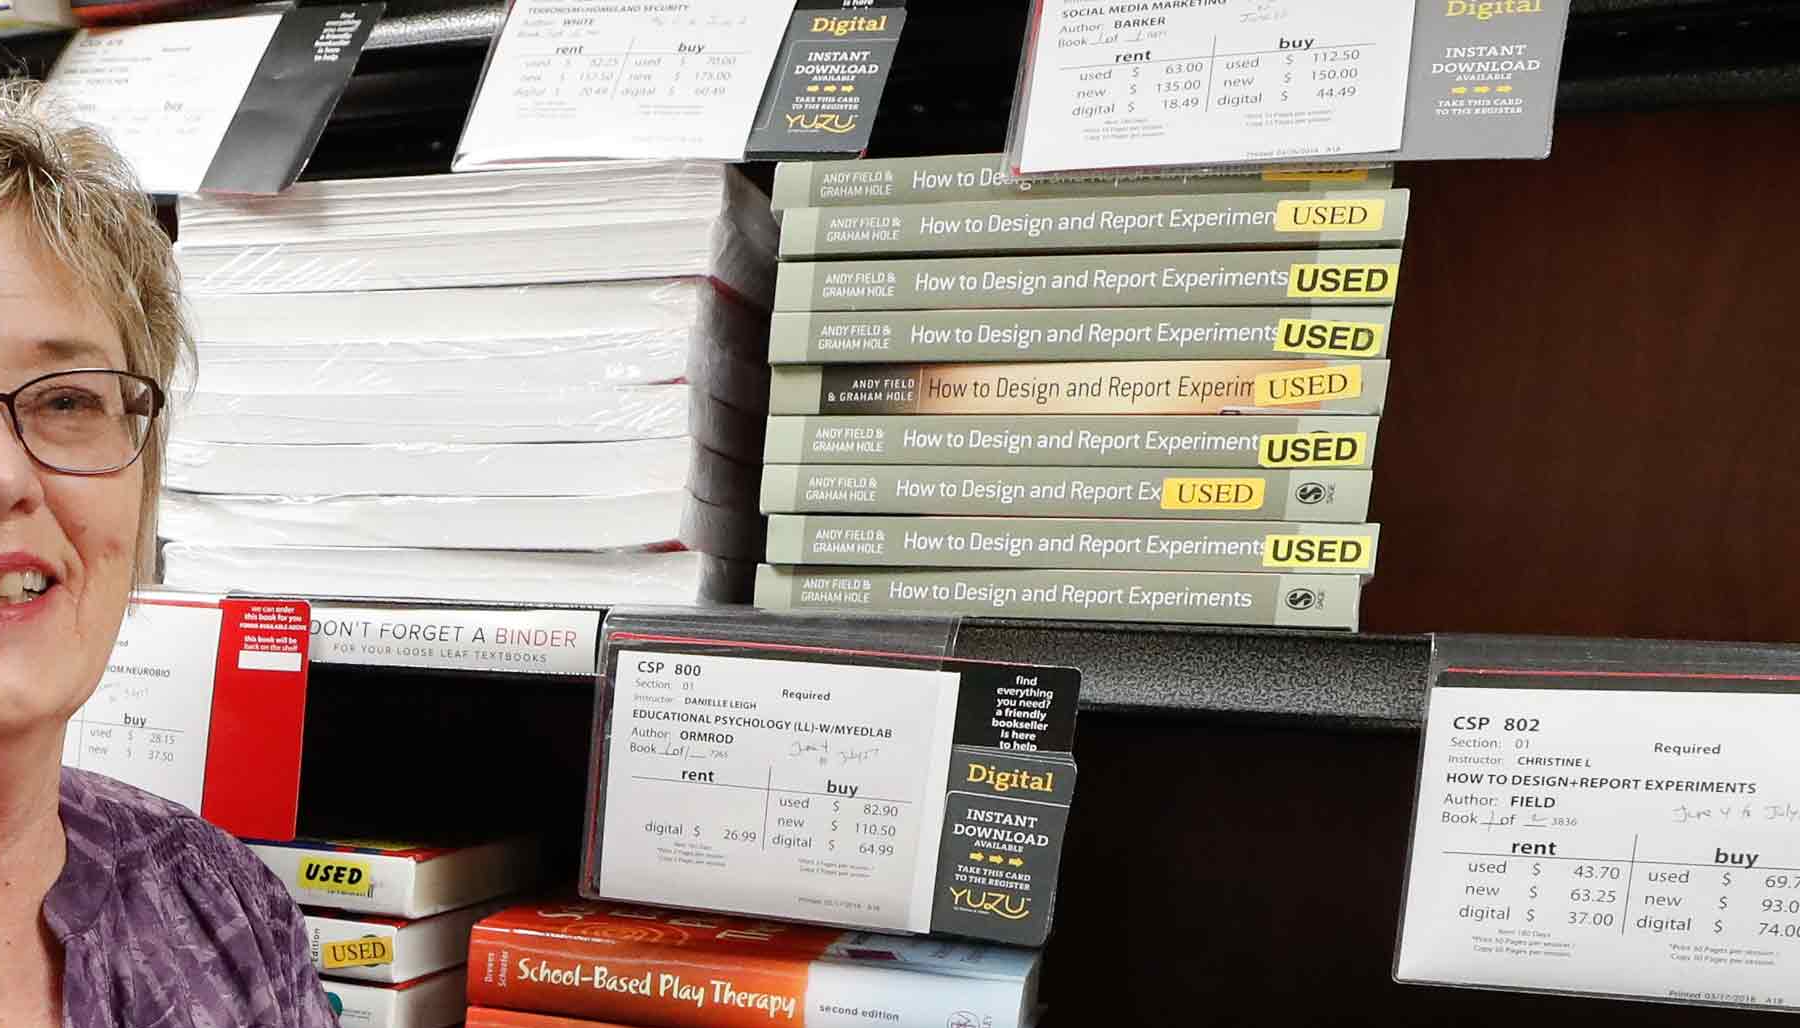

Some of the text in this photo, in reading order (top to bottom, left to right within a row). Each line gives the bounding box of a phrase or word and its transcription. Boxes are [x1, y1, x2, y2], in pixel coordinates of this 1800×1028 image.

[1062, 3, 1157, 18] SOCIAL MEDIA
[810, 15, 887, 34] Digital
[1114, 16, 1166, 30] BARKER
[1278, 36, 1314, 51] buy
[1445, 45, 1527, 58] INSTANT
[1114, 49, 1151, 64] rent
[1312, 48, 1361, 62] 112.50
[794, 63, 878, 76] DOWNLOAD
[1311, 68, 1358, 81] 150.00
[1431, 59, 1541, 75] DOWNLOAD
[1316, 85, 1356, 99] 44.49
[785, 112, 857, 133] YUZU
[1293, 206, 1367, 225] USED
[825, 273, 896, 285] ANDY FIELD &
[916, 269, 1288, 294] How to Design and Report Experiments
[1297, 269, 1388, 291] USED
[822, 286, 894, 297] GRAHAM HOLE
[1284, 324, 1374, 350] USED
[929, 375, 1255, 404] How to Design and Report Experim
[1269, 374, 1347, 399] USED
[1267, 437, 1358, 462] USED
[1178, 483, 1254, 504] USED
[1272, 539, 1362, 562] USED
[890, 582, 1251, 610] How to Design and Report Experiments
[310, 620, 576, 648] DON'T FORGET A BINDER
[334, 644, 546, 662] FOR YOUR LOOSE LEAF TEXTBOOKS
[638, 661, 701, 676] CSP 800
[782, 688, 830, 701] Required
[997, 686, 1053, 699] everything
[684, 696, 756, 710] DANIELLE LEIGH
[124, 713, 146, 728] buy
[632, 709, 892, 738] EDUCATIONAL PSYCHOLOGY (LL)-W/MYEDLAB
[992, 718, 1048, 731] bookseller
[1453, 716, 1540, 733] CSP 802
[680, 730, 734, 744] ORMROD
[1654, 742, 1721, 756] Required
[1517, 756, 1581, 767] CHRISTINE
[682, 768, 714, 783] rent
[967, 764, 1053, 792] Digital
[1446, 773, 1756, 794] HOW TO DESIGN+REPORT EXPERIMENTS
[826, 780, 858, 798] buy
[779, 798, 898, 816] used 82.90
[1510, 796, 1555, 808] FIELD
[778, 816, 896, 836] new 110.50
[966, 808, 1038, 828] INSTANT
[645, 822, 756, 842] digital 26.99
[953, 824, 1048, 847] DOWNLOAD
[772, 834, 894, 856] digital 64.99
[975, 839, 1023, 852] AVAILABLE
[1511, 840, 1557, 856] rent
[1714, 849, 1759, 868] buy
[305, 863, 362, 884] USED
[1574, 865, 1620, 880] 43.70
[950, 887, 1030, 919] YUZU
[1570, 889, 1617, 903] 63.25
[1568, 913, 1614, 927] 37.00
[333, 942, 385, 961] USED
[518, 959, 797, 1019] School-Based Play Therapy
[820, 1004, 899, 1022] second edition
